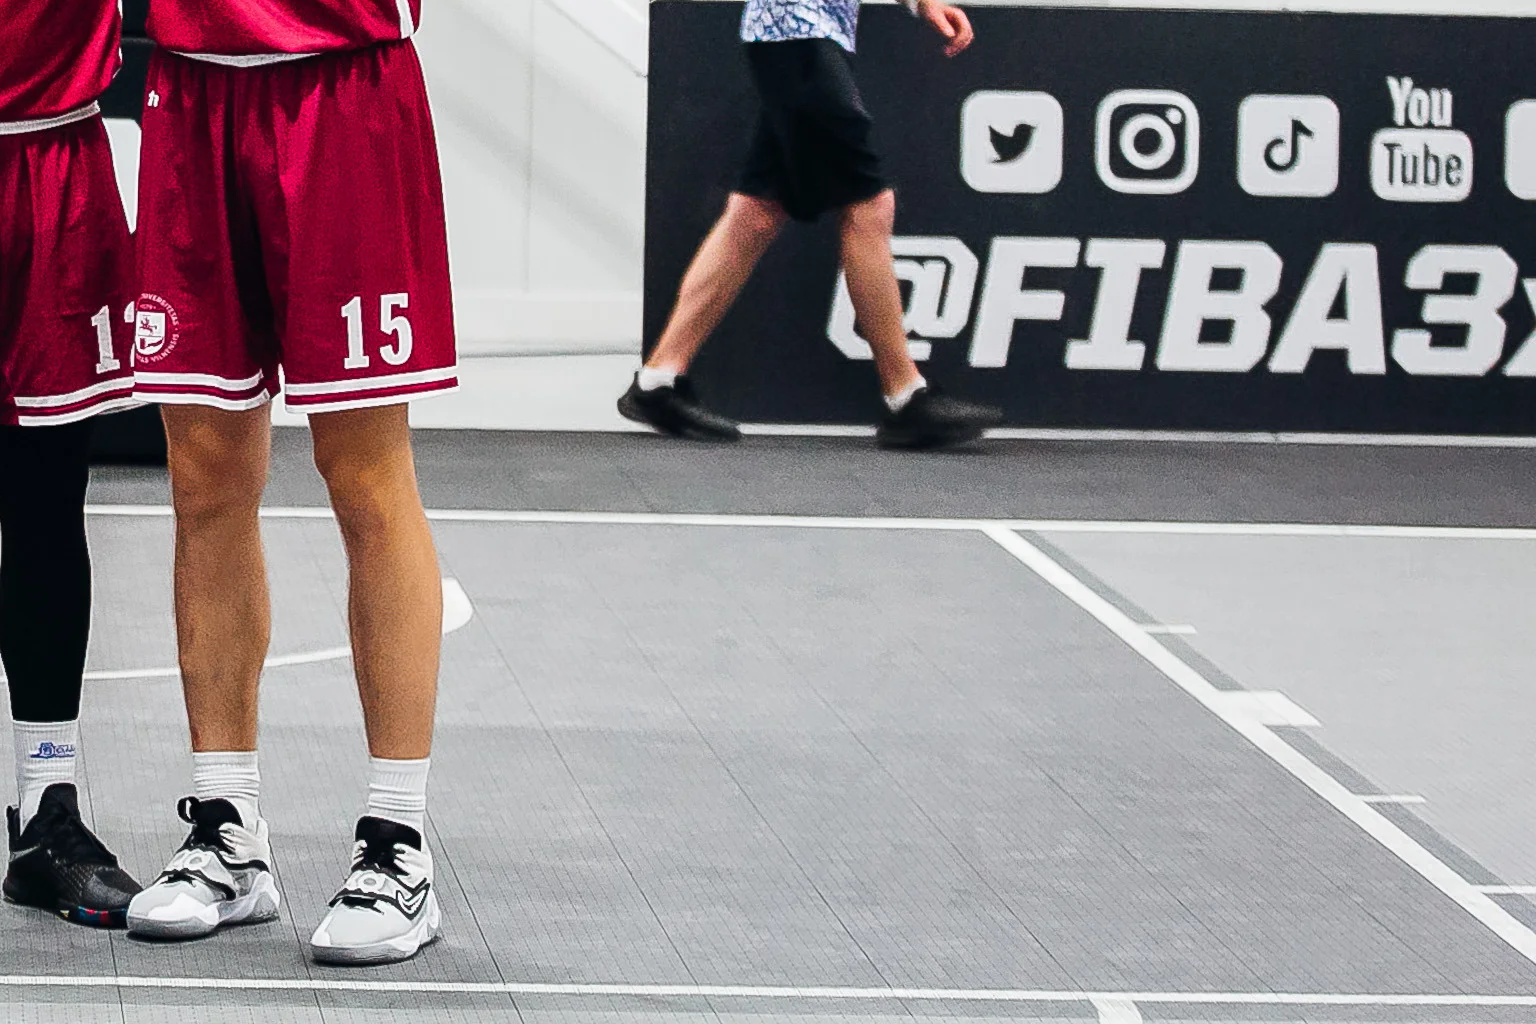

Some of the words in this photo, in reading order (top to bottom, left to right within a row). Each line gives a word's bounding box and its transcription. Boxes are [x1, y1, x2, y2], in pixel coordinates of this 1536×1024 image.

[1386, 76, 1454, 128] You
[1382, 142, 1463, 187] Tube
[340, 292, 414, 370] 15
